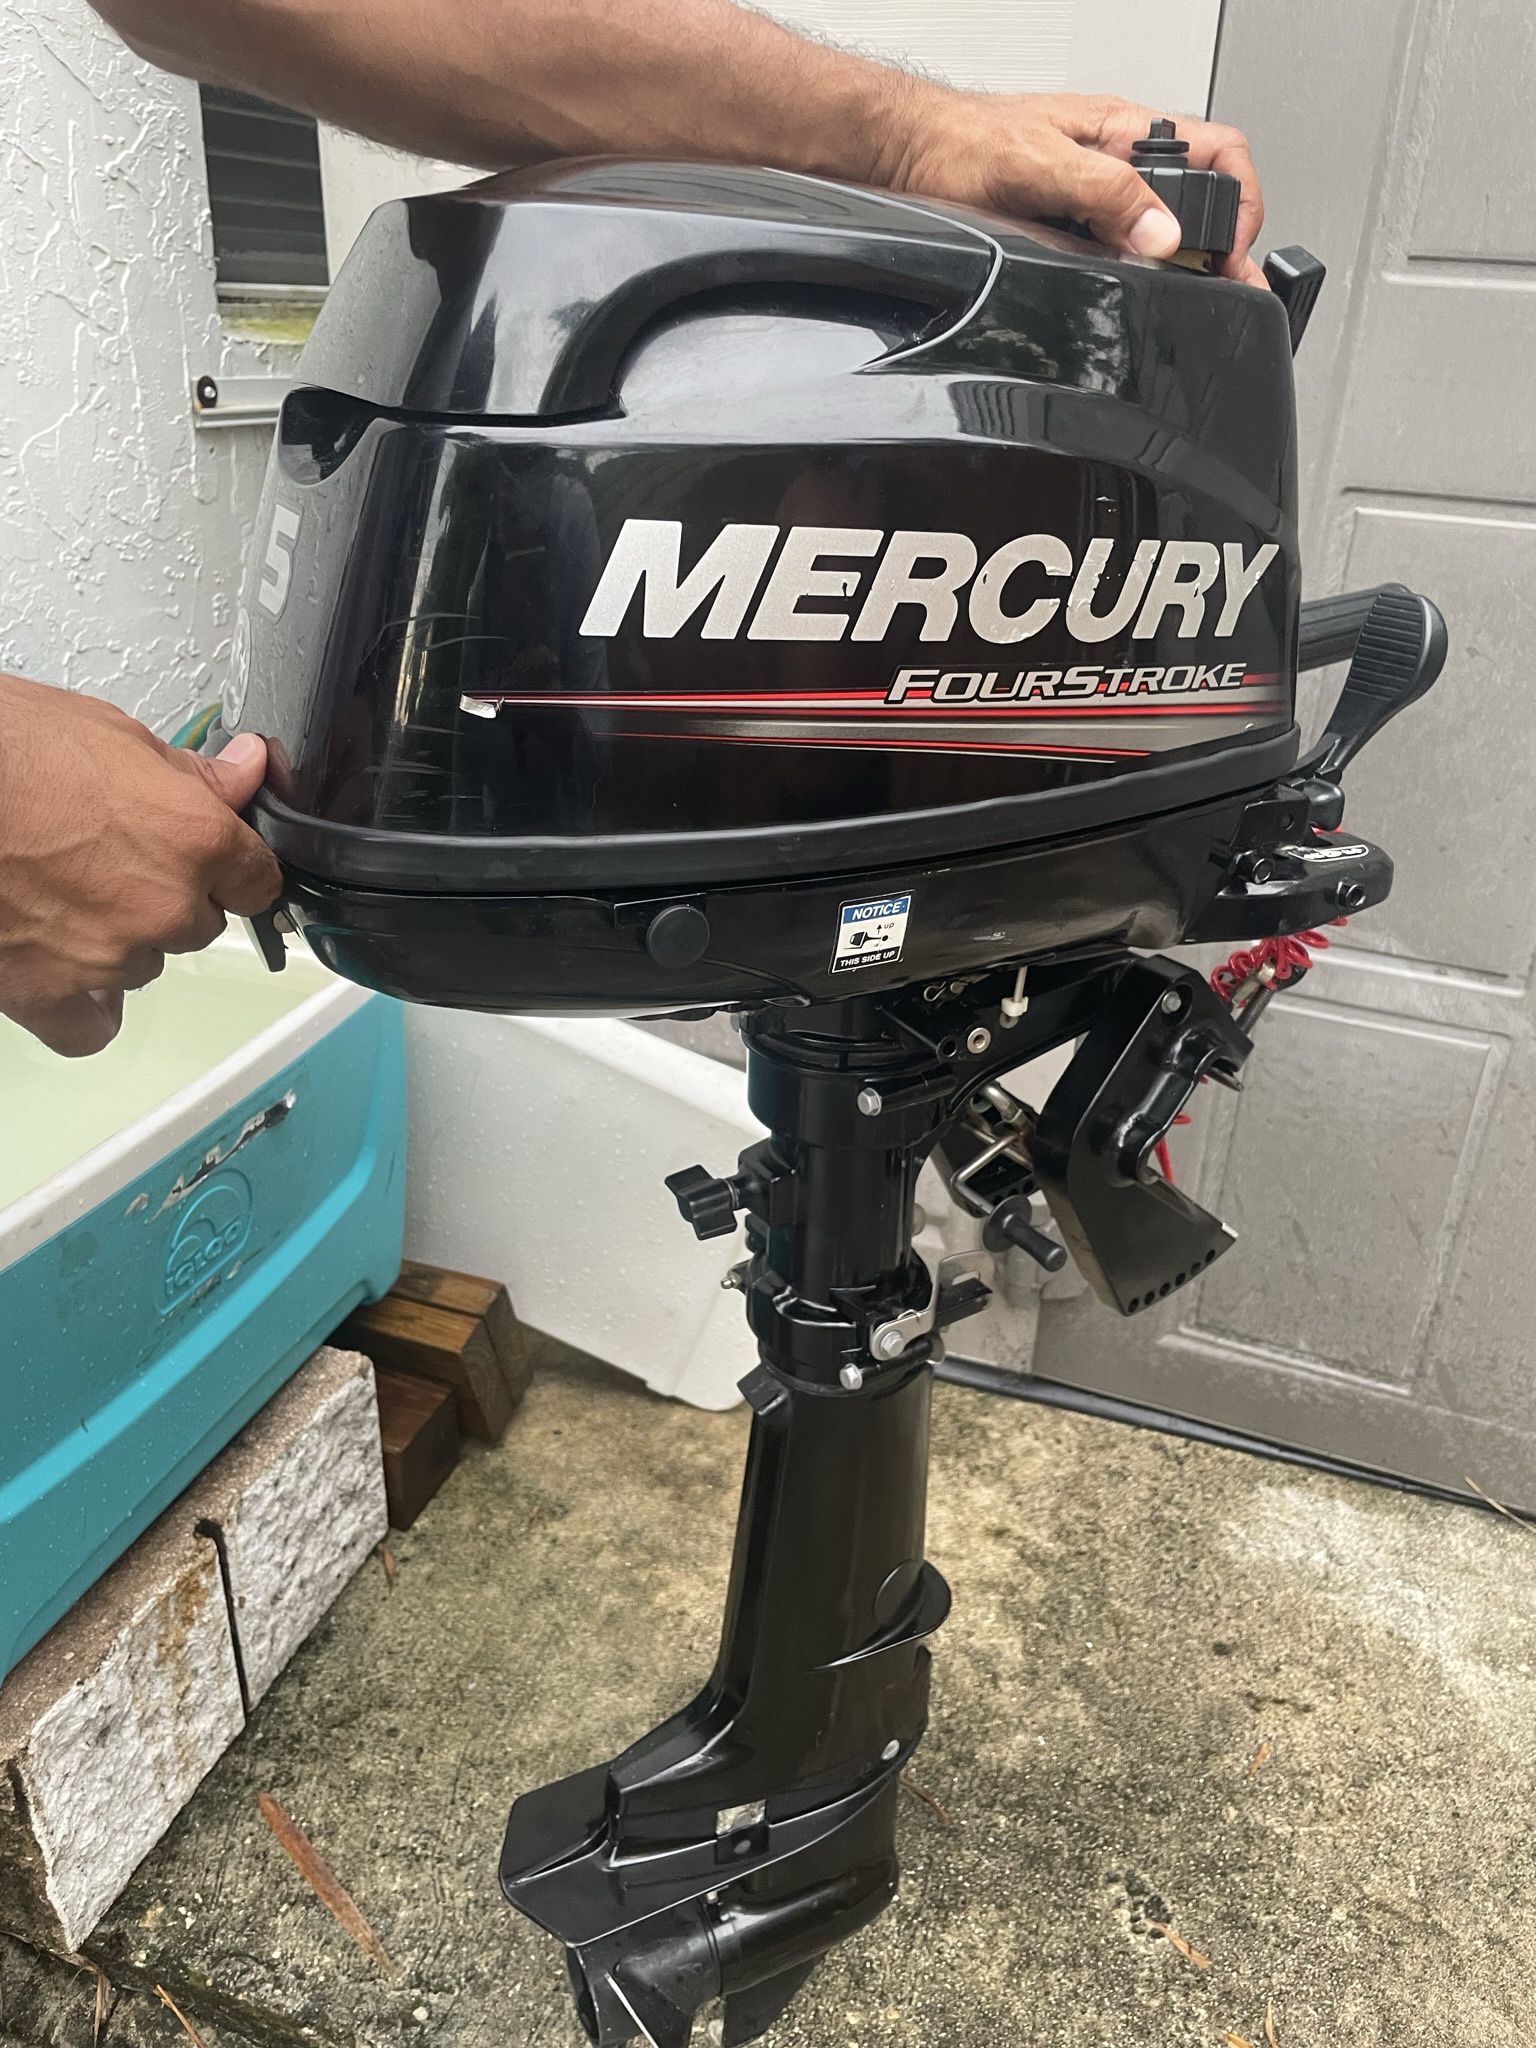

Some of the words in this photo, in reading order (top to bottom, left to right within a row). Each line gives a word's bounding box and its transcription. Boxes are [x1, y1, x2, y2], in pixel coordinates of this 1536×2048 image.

[258, 504, 300, 616] 5
[578, 518, 1280, 644] MERCURY
[852, 901, 902, 920] NOTICE
[840, 957, 860, 967] THIS
[861, 953, 881, 963] SIDE
[882, 950, 896, 959] UP
